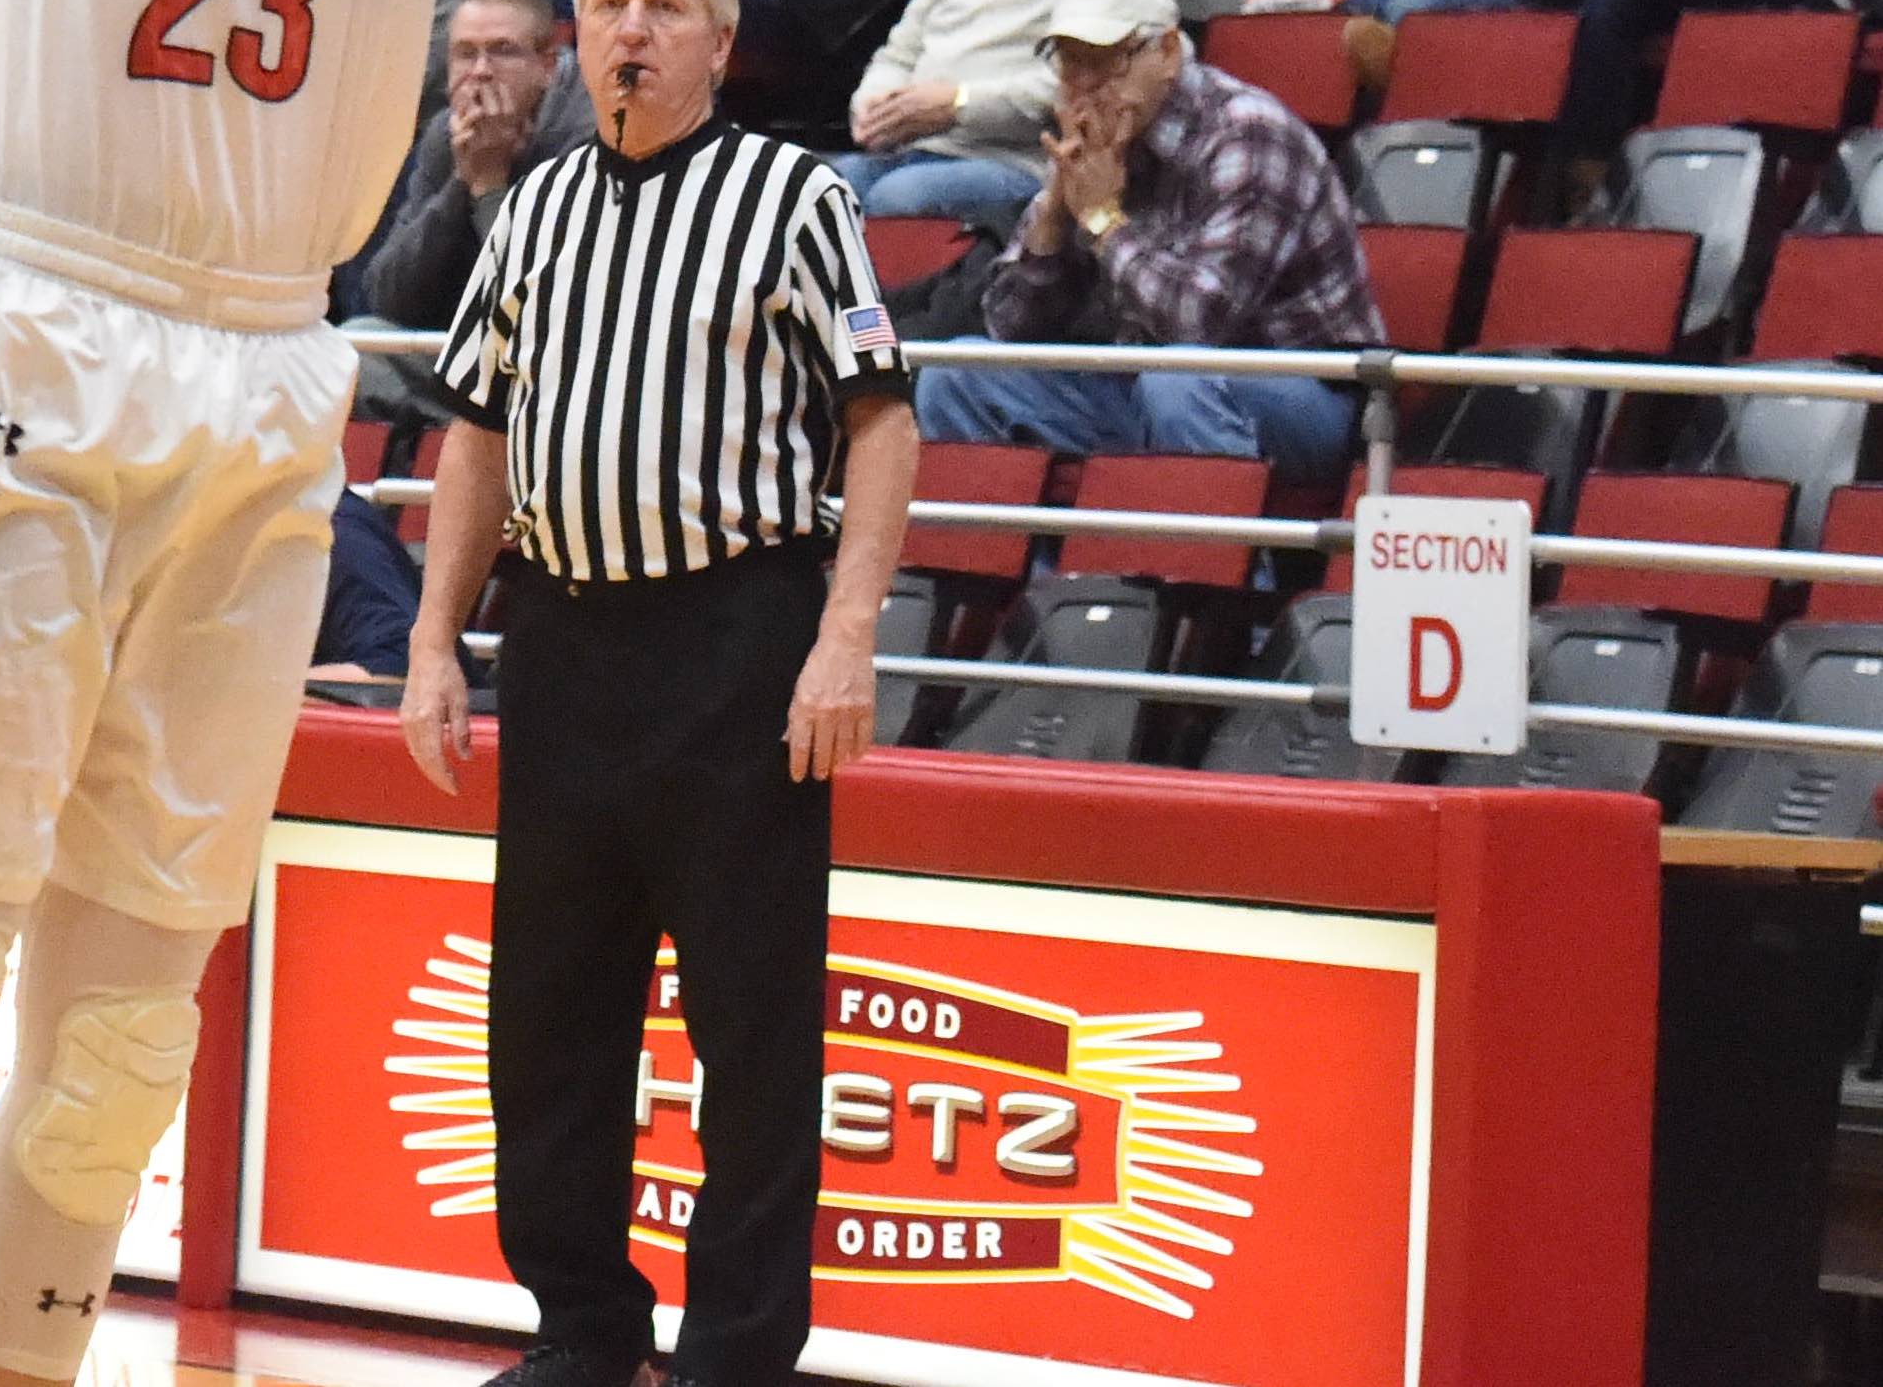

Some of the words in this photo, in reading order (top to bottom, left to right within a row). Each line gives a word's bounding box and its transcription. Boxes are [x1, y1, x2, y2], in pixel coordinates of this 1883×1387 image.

[1370, 531, 1509, 576] SECTION
[1408, 615, 1464, 712] D
[838, 987, 962, 1040] FOOD
[634, 1048, 1079, 1178] HETZ
[636, 1181, 696, 1228] AD
[835, 1217, 1005, 1261] ORDER
